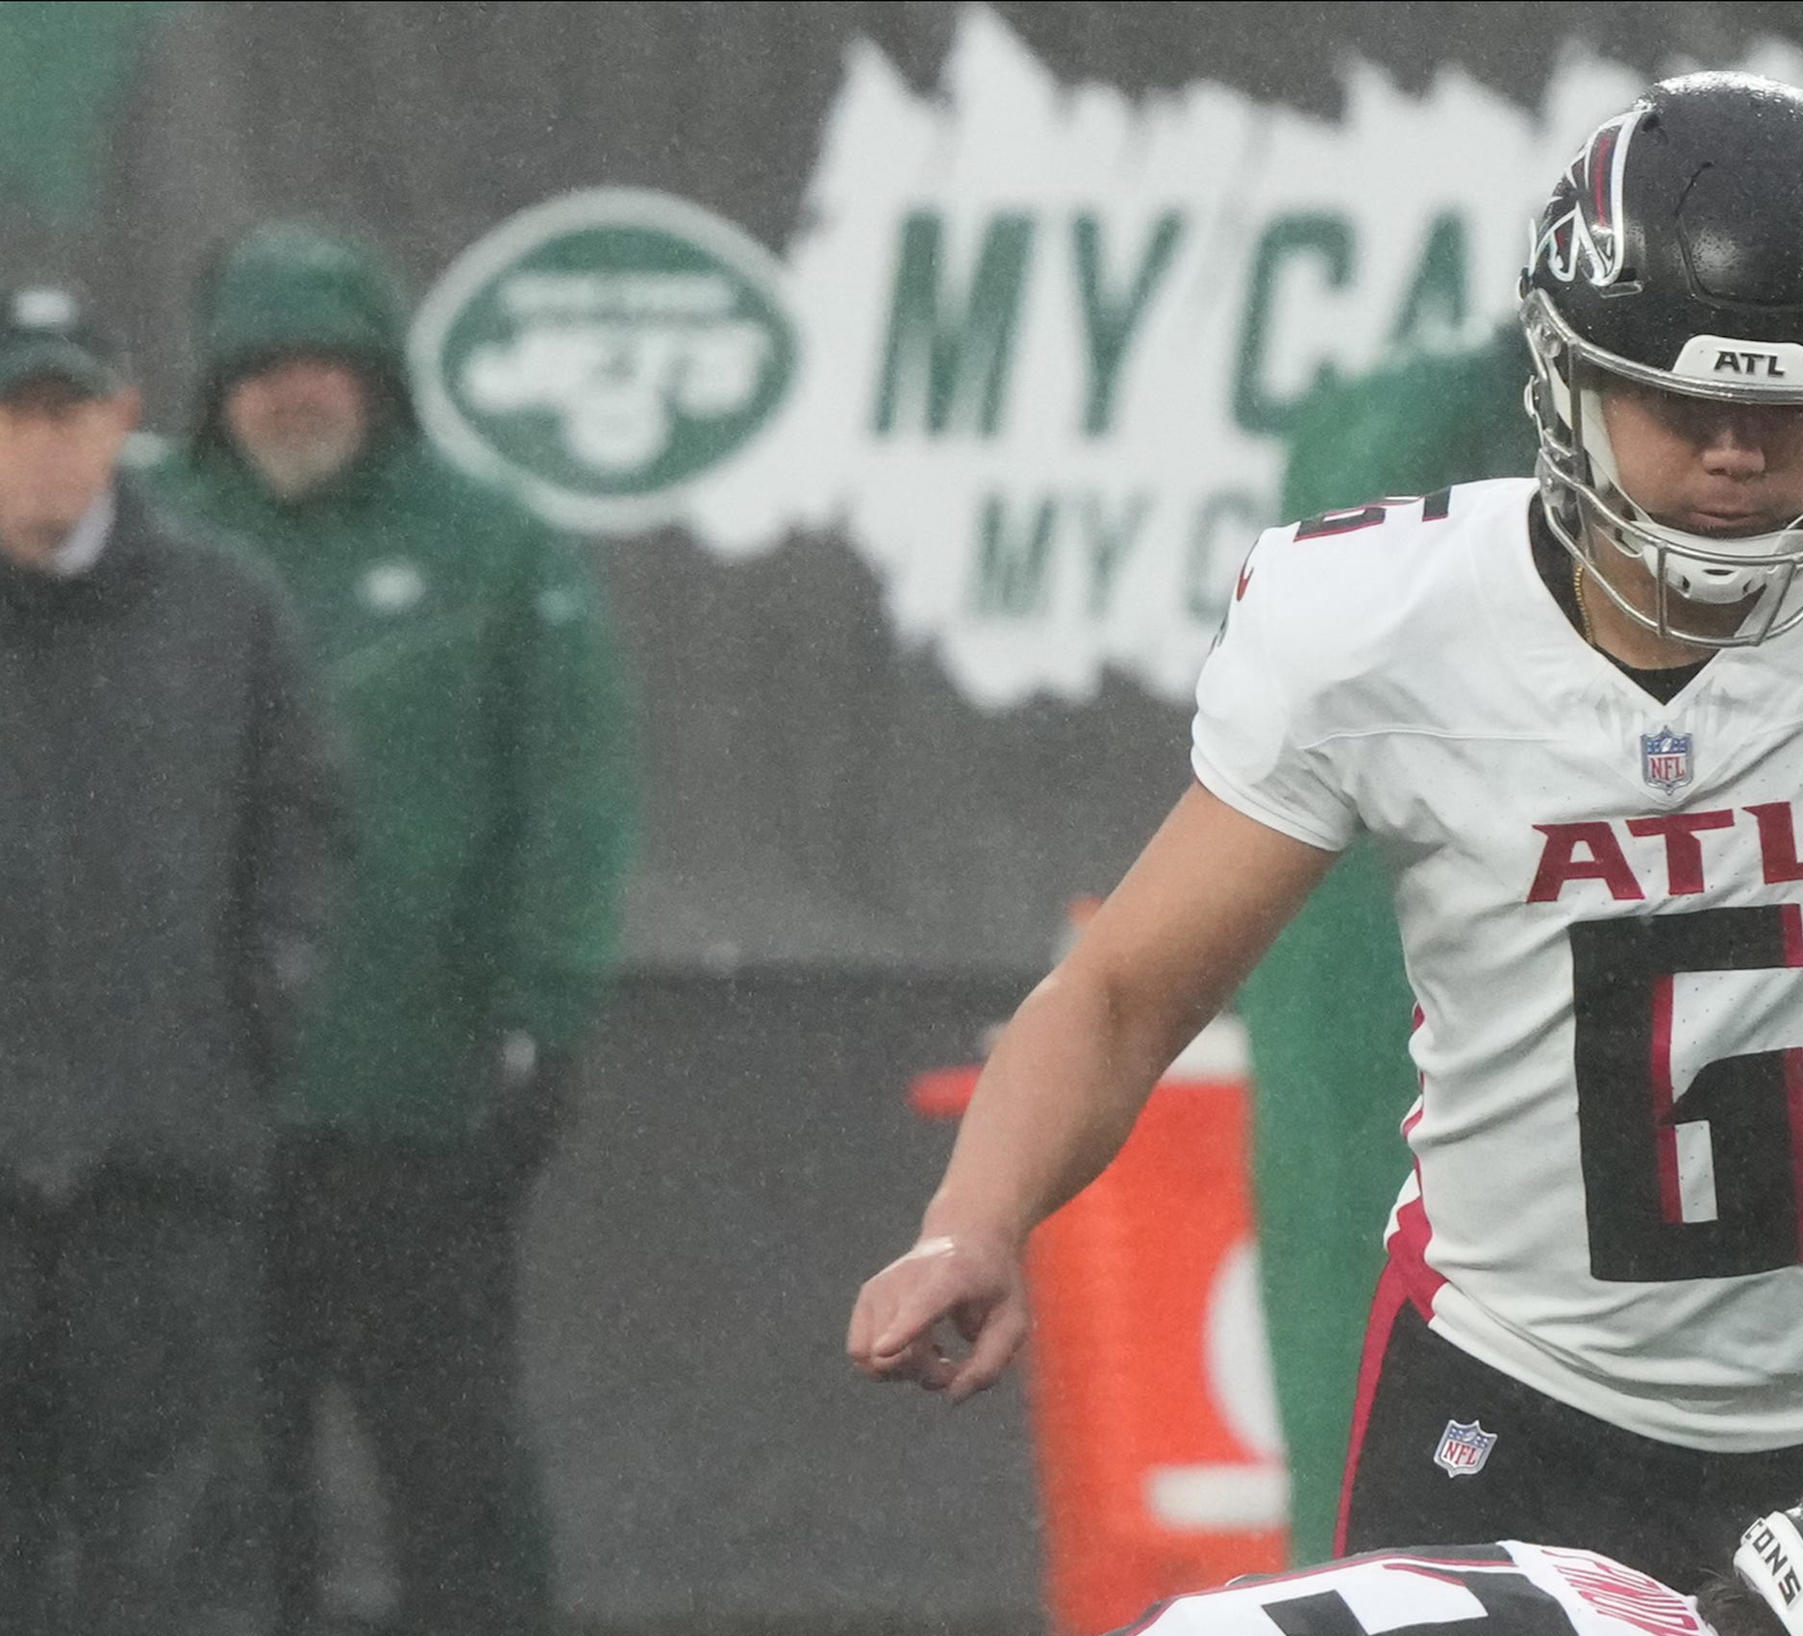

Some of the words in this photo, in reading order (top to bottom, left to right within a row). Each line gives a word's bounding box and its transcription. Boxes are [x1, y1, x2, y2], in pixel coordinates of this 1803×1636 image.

[876, 208, 1190, 436] MY
[1713, 350, 1786, 377] ATL
[968, 491, 1156, 618] MY
[1649, 755, 1686, 781] NFL
[1442, 1440, 1477, 1466] NFL
